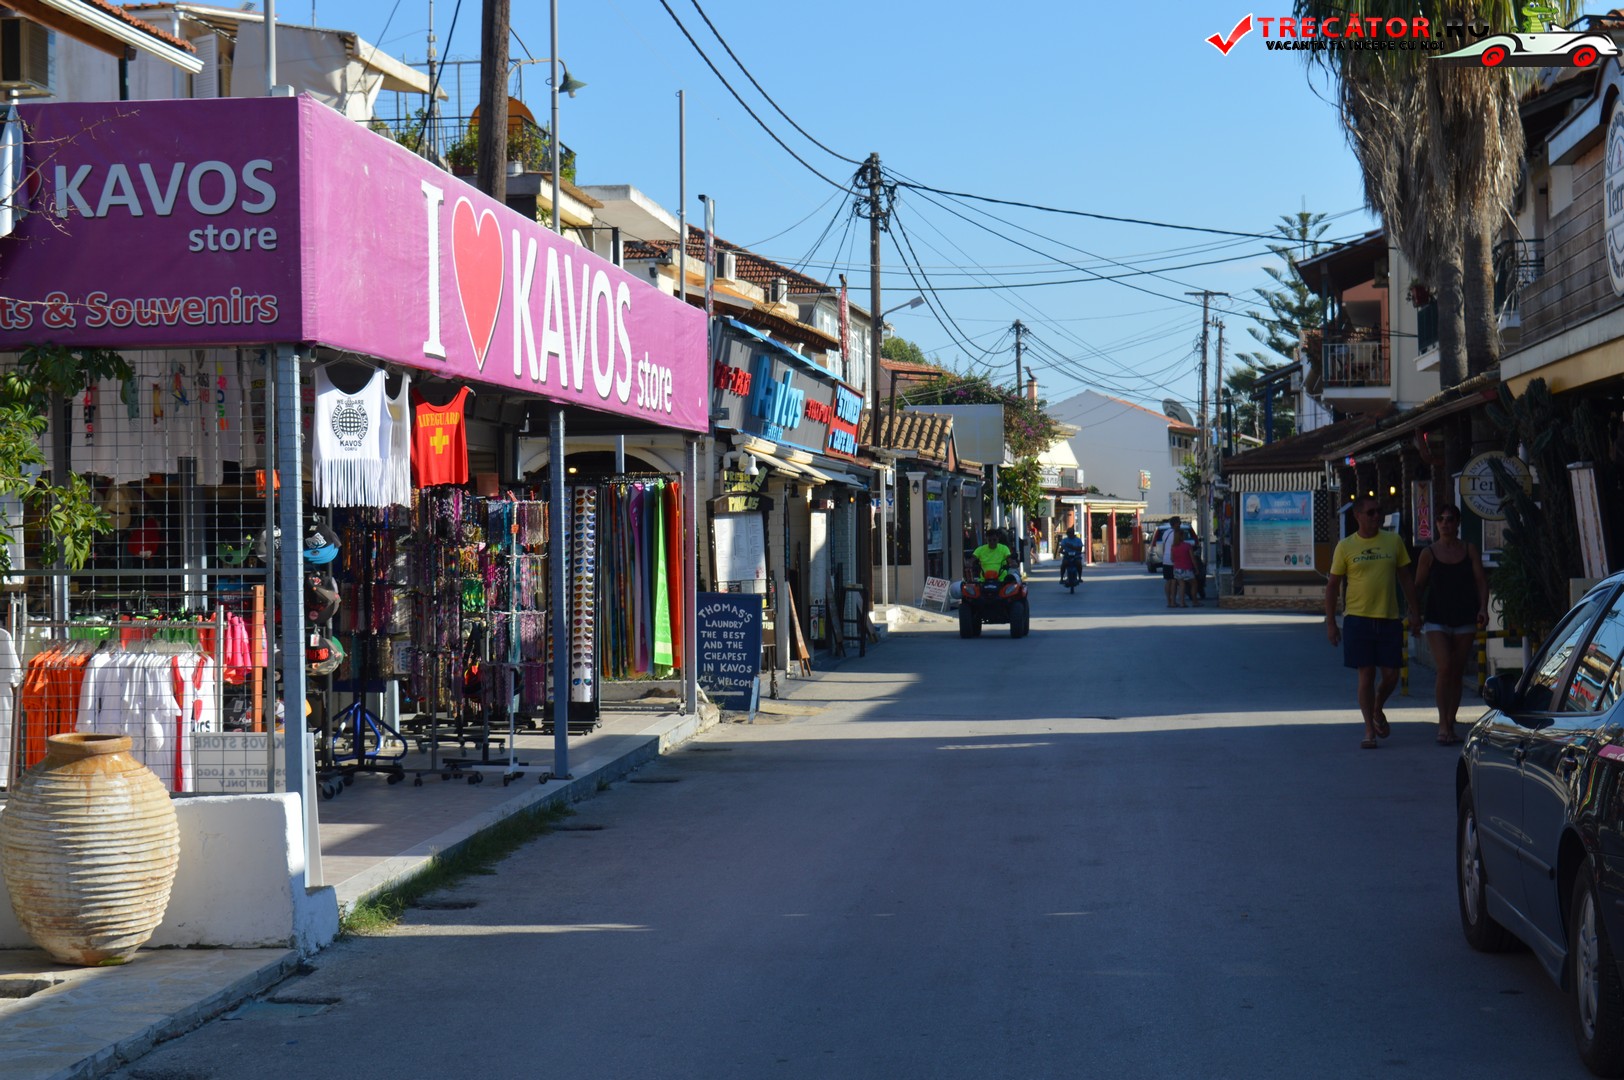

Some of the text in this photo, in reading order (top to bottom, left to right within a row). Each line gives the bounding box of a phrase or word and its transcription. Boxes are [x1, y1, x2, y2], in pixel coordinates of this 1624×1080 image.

[54, 158, 278, 218] KAVOS
[188, 224, 278, 251] store
[421, 179, 673, 413] I KAVOS store
[42, 291, 77, 329] &
[85, 286, 280, 328] Souvenirs
[417, 412, 460, 427] LIFEGUARD
[698, 603, 753, 623] THOMAS'S
[705, 620, 743, 629] LAUNDRY
[701, 631, 746, 640] THE BEST
[703, 641, 743, 649] AND THE
[704, 652, 748, 661] CHEAPEST
[703, 663, 753, 673] IN KAVOS
[717, 677, 753, 688] WELCOM
